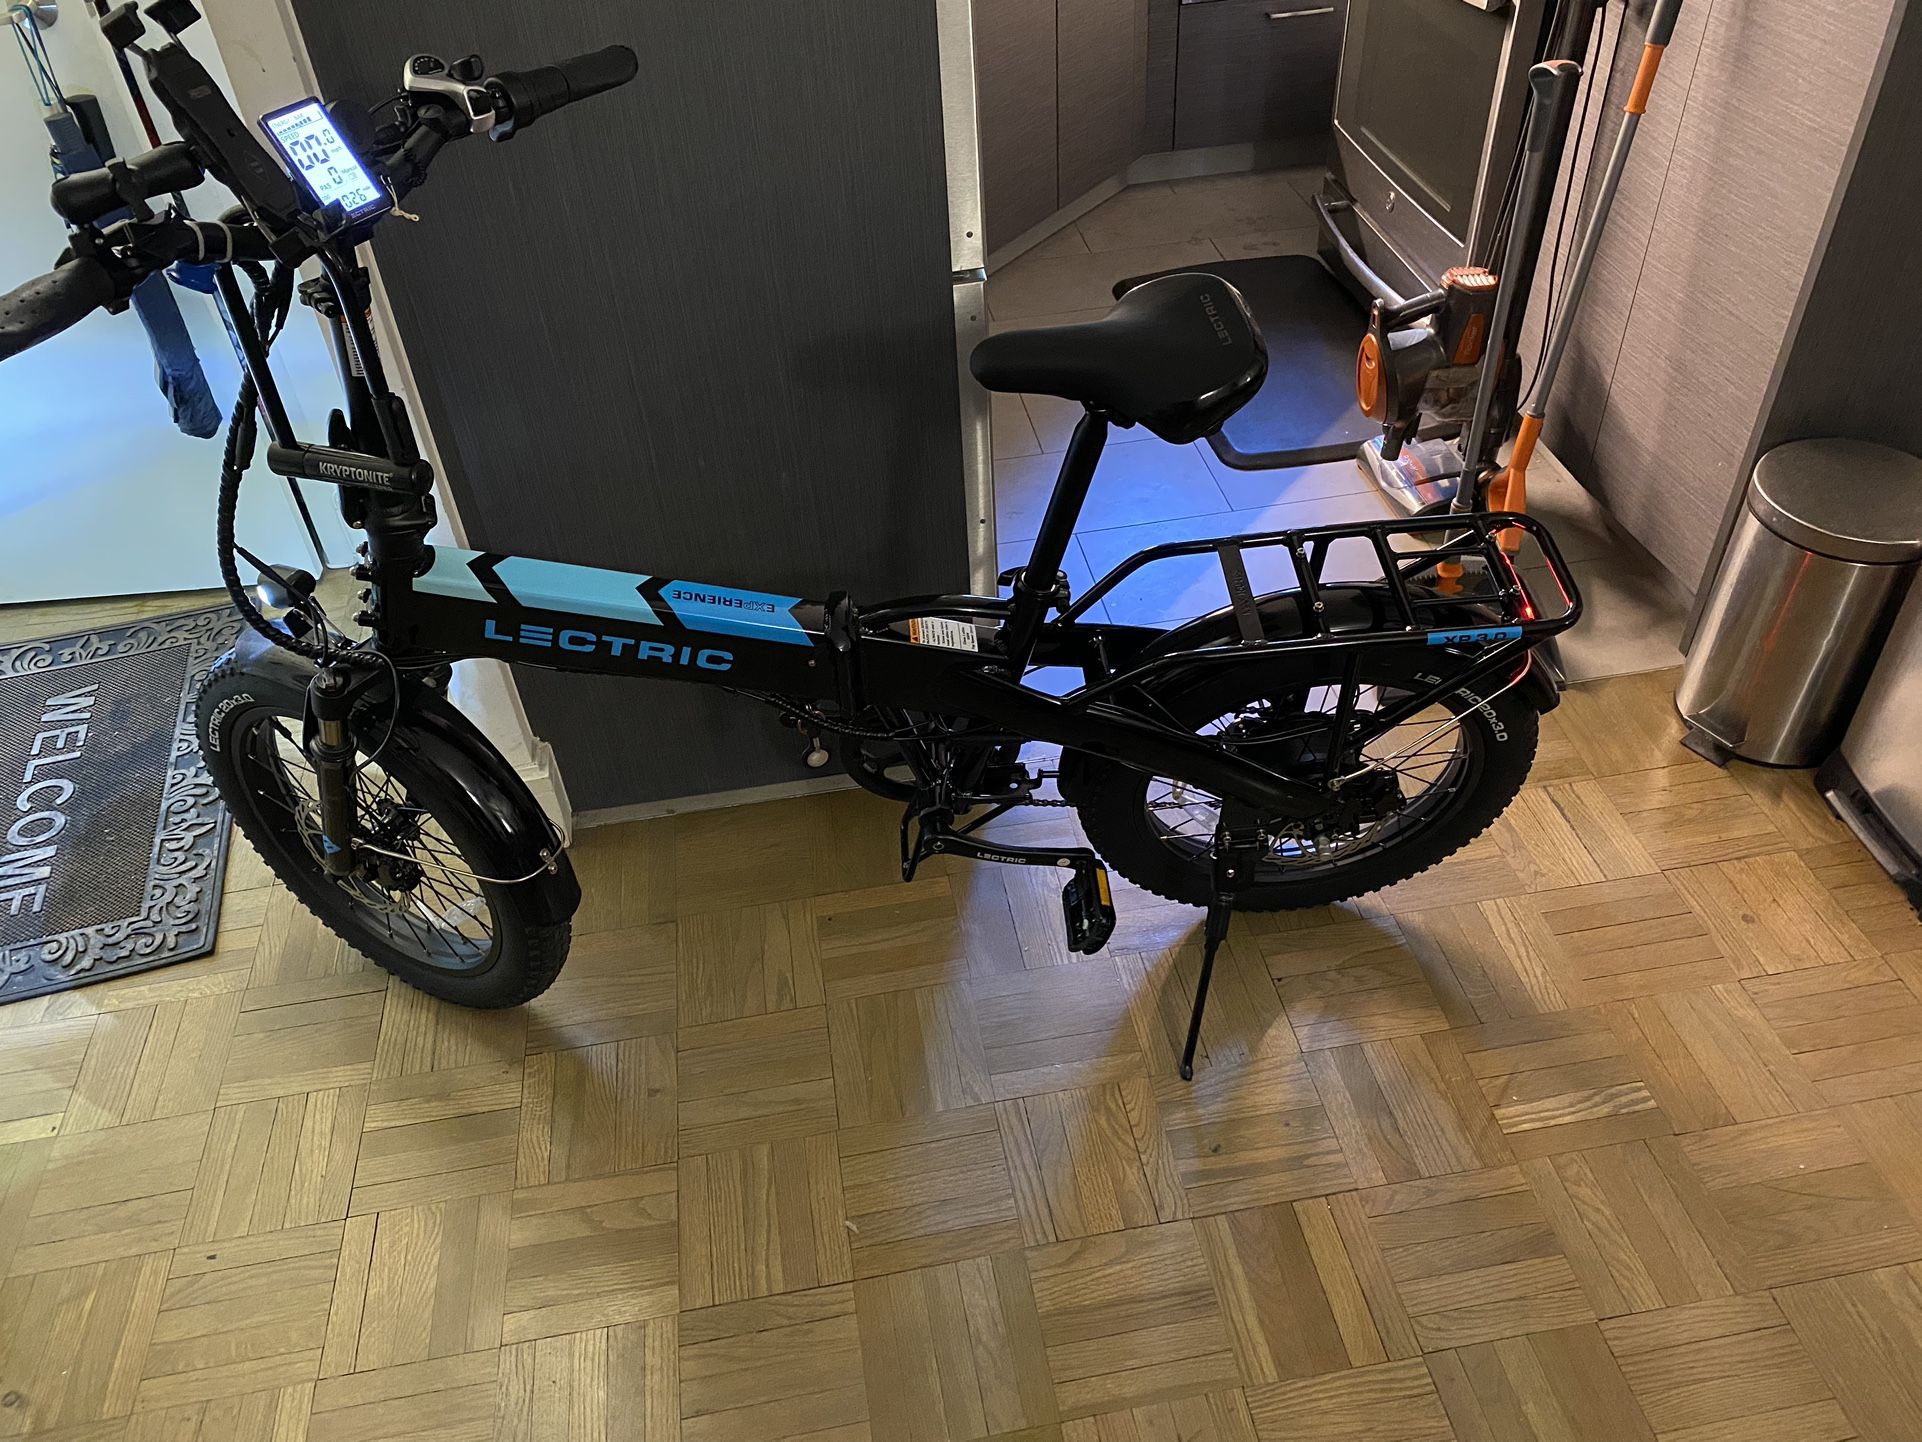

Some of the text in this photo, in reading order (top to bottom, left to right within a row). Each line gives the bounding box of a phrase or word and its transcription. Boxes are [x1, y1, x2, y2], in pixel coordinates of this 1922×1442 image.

[280, 131, 300, 143] SPEED
[319, 183, 332, 191] PAS
[341, 188, 367, 208] 026
[1200, 293, 1233, 346] LECTRIC
[319, 462, 391, 485] KRYPTONITE
[672, 589, 775, 613] EXPERIENCE
[484, 619, 734, 671] LECTRIC
[1443, 634, 1472, 644] XP
[1413, 672, 1482, 705] LERIC
[208, 708, 226, 753] LECTRIC
[976, 851, 1026, 864] LECTRIC
